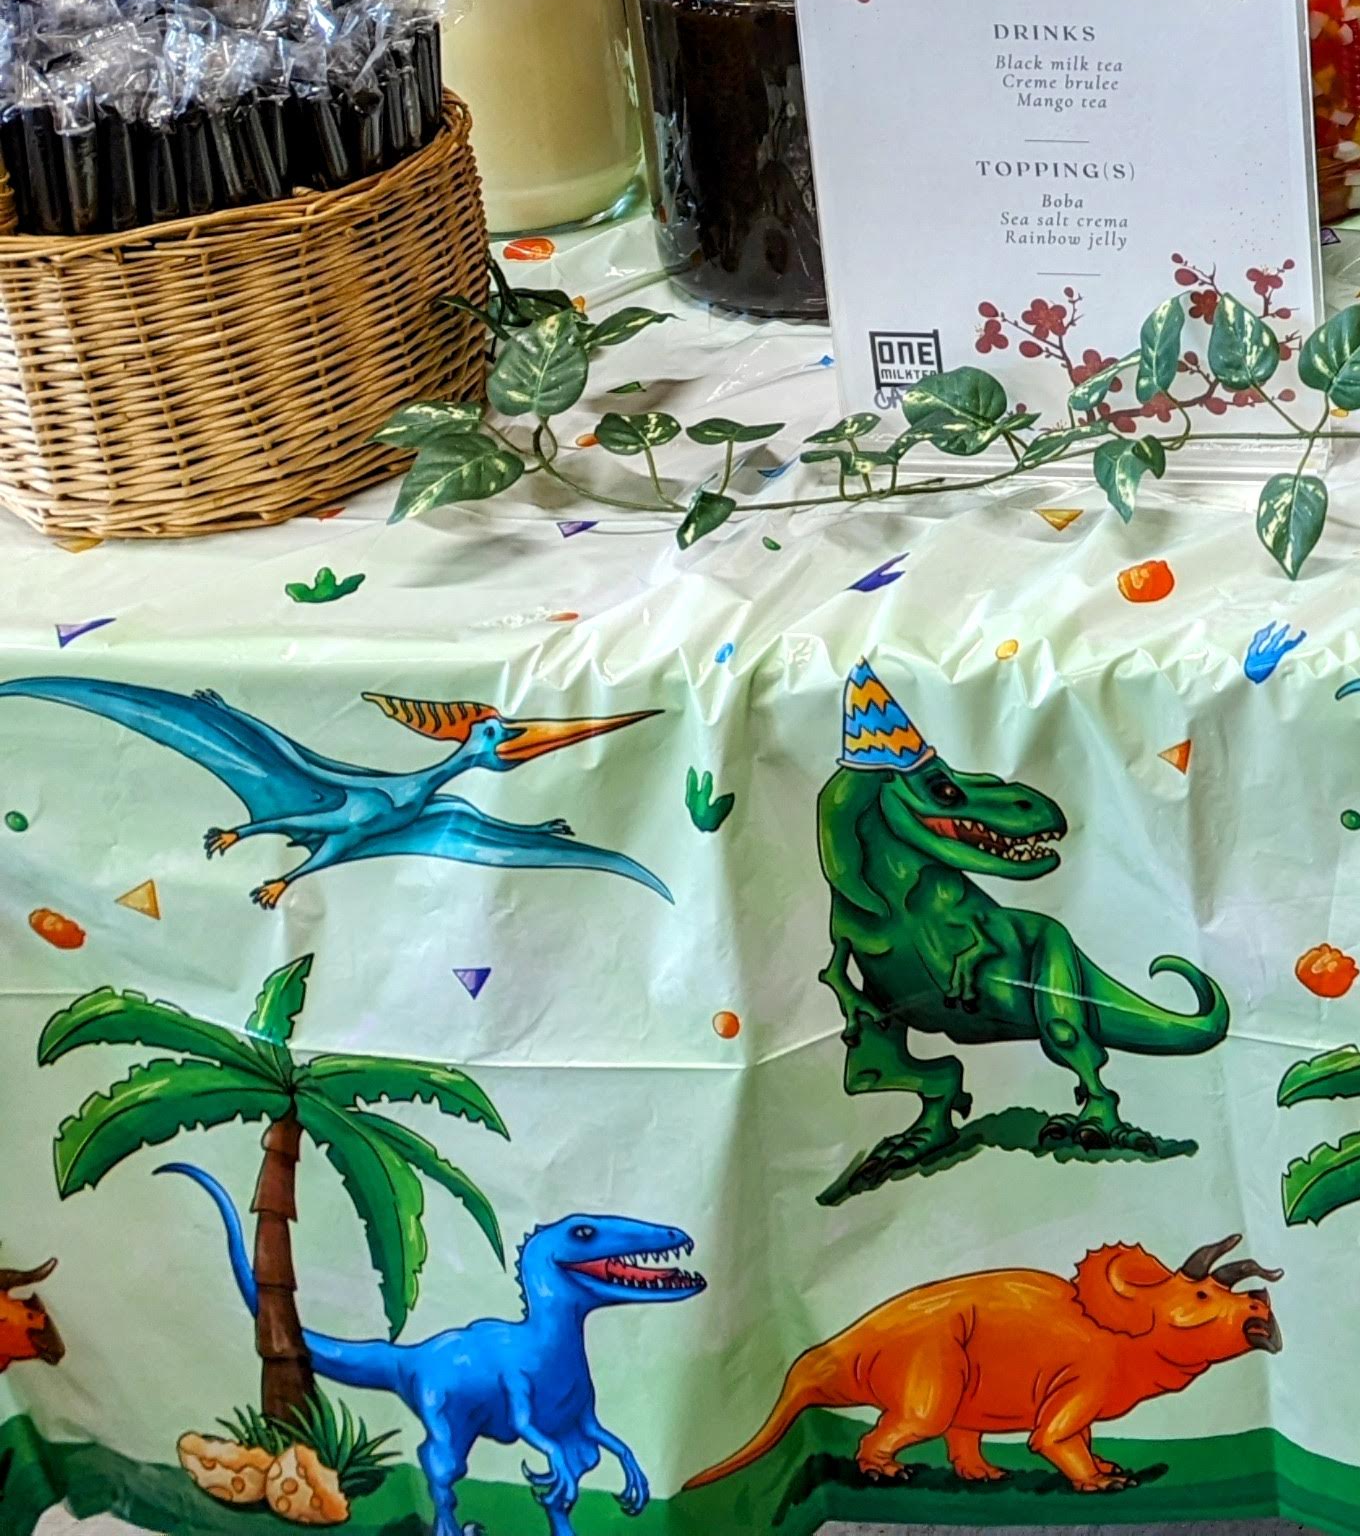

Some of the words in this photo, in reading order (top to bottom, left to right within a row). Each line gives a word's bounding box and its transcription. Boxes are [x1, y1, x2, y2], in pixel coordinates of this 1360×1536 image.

[993, 23, 1096, 42] DRINKS
[995, 53, 1043, 71] Black
[1050, 55, 1089, 71] milk
[1096, 60, 1123, 72] tea
[1002, 73, 1057, 89] Creme
[1064, 74, 1119, 90] brulee
[1017, 92, 1074, 113] Mango
[1081, 97, 1107, 109] tea
[975, 160, 1135, 182] TOPPING(S)
[1042, 193, 1084, 209] Boba
[1000, 211, 1029, 227] Sea
[1037, 211, 1069, 227] salt
[1077, 216, 1128, 228] crema
[1005, 230, 1081, 245] Rainbow
[1087, 231, 1127, 251] jelly
[878, 341, 934, 365] ONE
